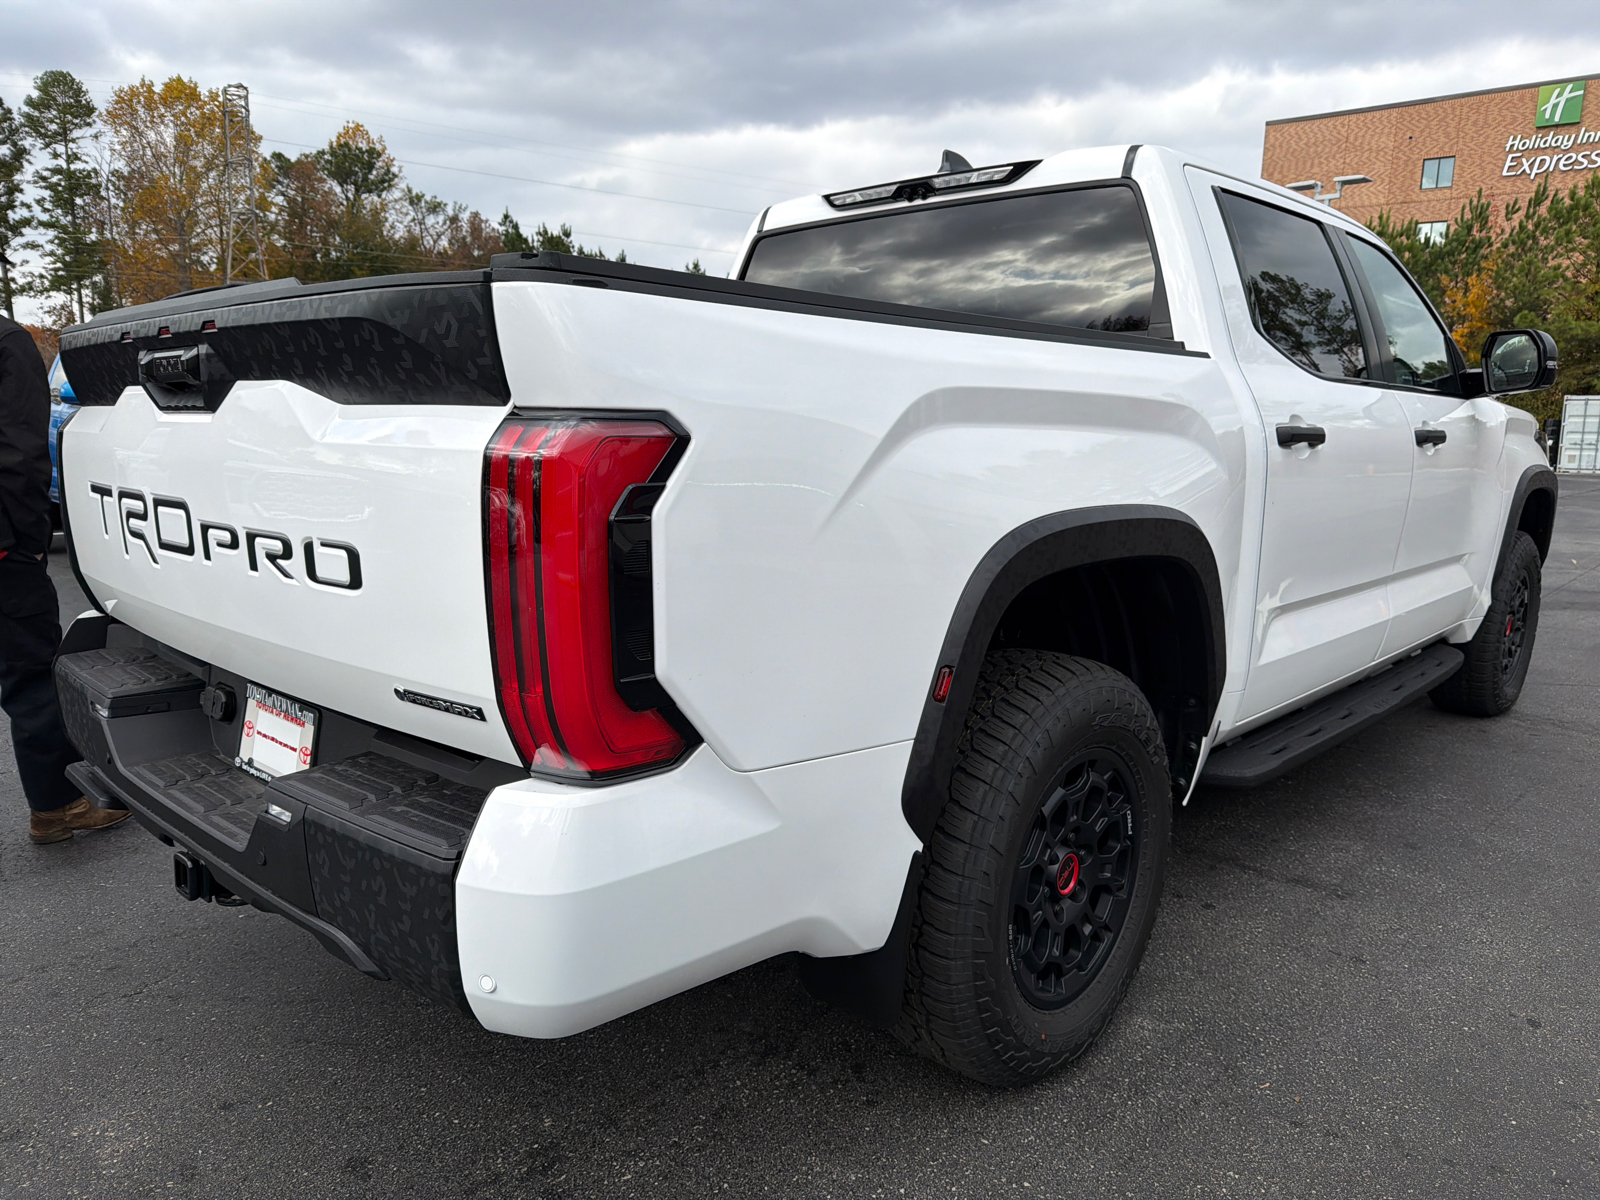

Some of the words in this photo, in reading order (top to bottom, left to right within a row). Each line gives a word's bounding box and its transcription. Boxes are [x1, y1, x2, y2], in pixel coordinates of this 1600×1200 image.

[1505, 131, 1576, 152] Holiday
[1501, 150, 1600, 180] Express
[88, 480, 197, 569] TRD
[197, 518, 364, 592] PRO
[1091, 712, 1160, 765] FALKEN
